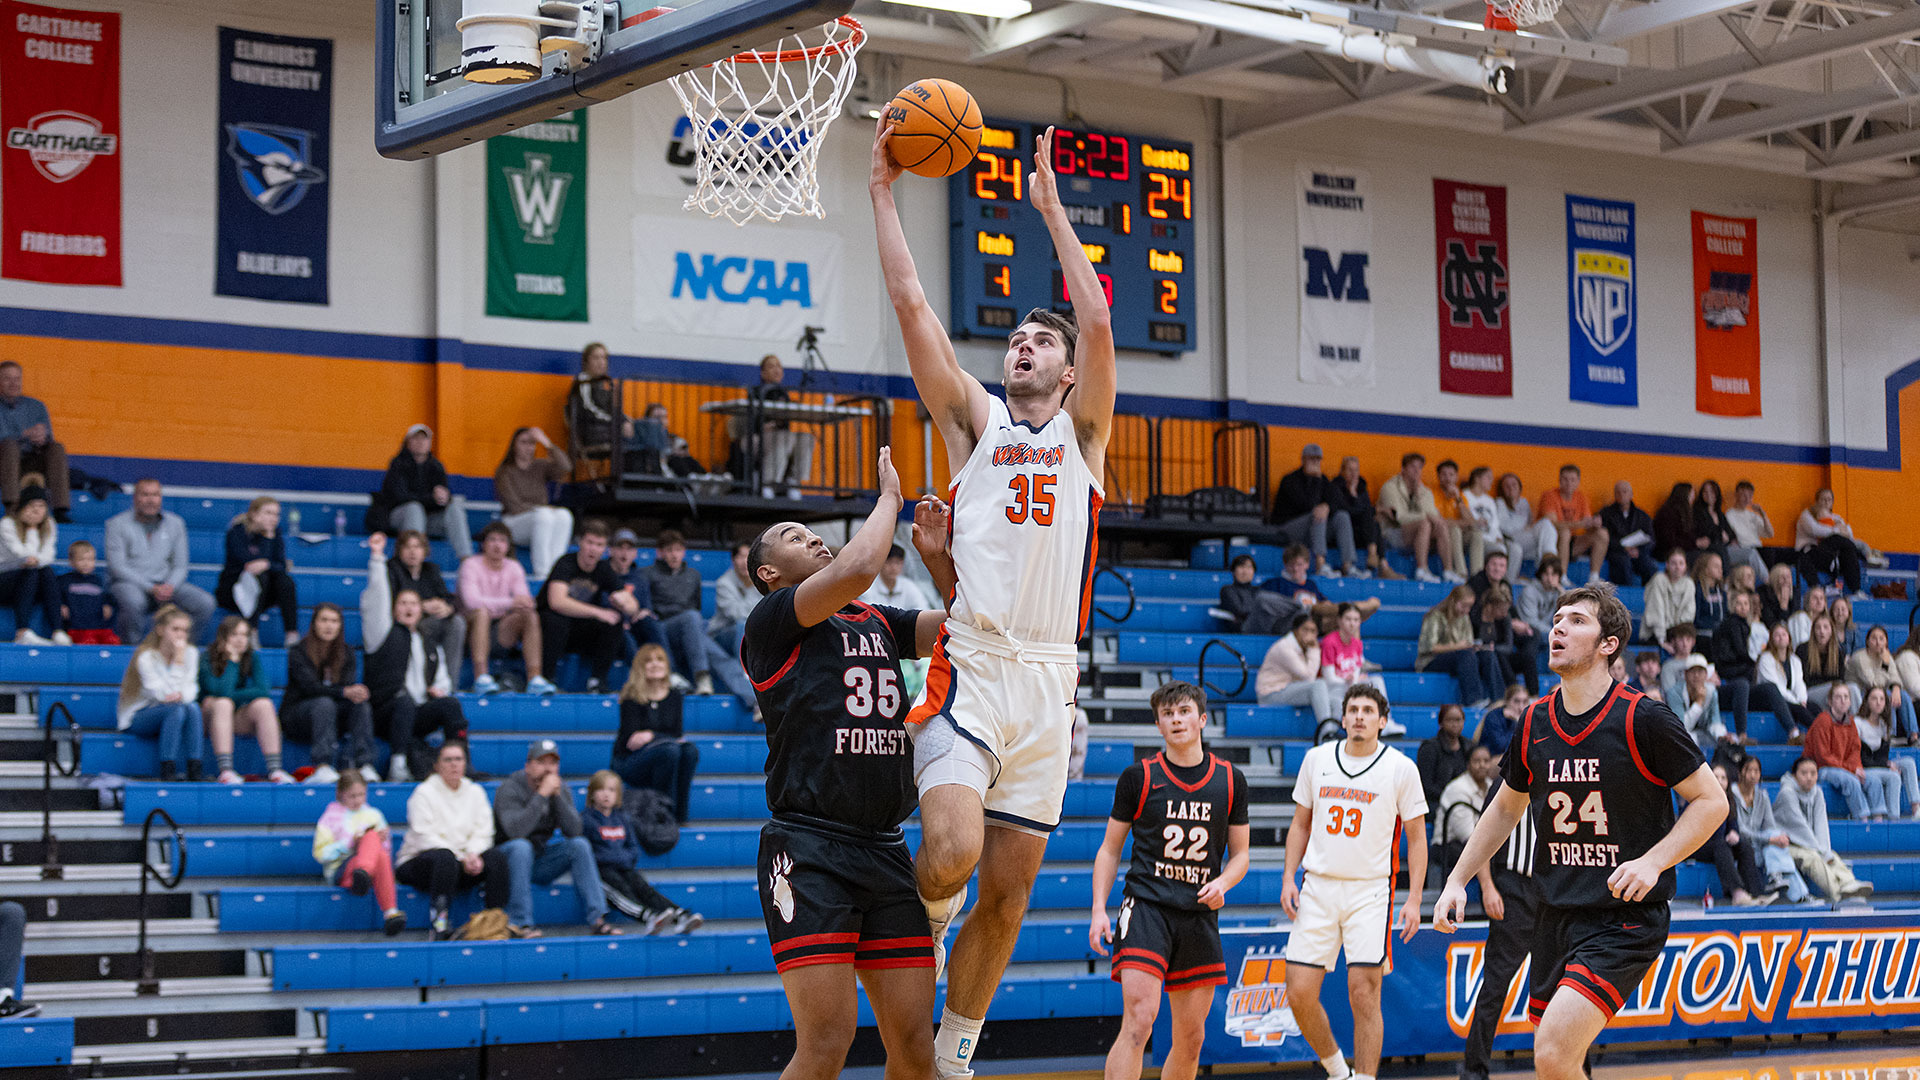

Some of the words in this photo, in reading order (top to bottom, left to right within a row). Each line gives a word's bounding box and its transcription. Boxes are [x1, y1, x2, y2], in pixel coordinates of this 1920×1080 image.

[16, 13, 103, 42] CARTHAGE
[25, 38, 94, 65] COLLEGE
[230, 61, 322, 91] UNIVERSITY
[10, 131, 112, 152] CARTHAGE
[1054, 128, 1130, 181] 6:23
[976, 152, 1022, 201] 24
[1147, 172, 1191, 220] 24
[1305, 190, 1364, 212] UNIVERSITY
[1571, 202, 1604, 223] NORTH
[1604, 206, 1630, 226] PARK
[1574, 221, 1629, 243] UNIVERSITY
[514, 273, 567, 296] TITANS
[670, 250, 813, 309] NCAA
[1302, 245, 1371, 303] M
[1160, 279, 1179, 315] 2
[1581, 276, 1628, 347] NP
[1587, 363, 1626, 385] VIKINGS
[991, 443, 1066, 468] WHEATON
[1005, 473, 1058, 527] 35
[840, 632, 889, 660] LAK
[843, 666, 901, 719] 35
[834, 727, 906, 756] FOREST
[1548, 758, 1601, 783] LAKE
[1166, 799, 1212, 822] LAKE
[1326, 804, 1363, 838] 33
[1547, 790, 1609, 837] 24
[1162, 824, 1209, 862] 22
[1547, 842, 1620, 868] FOREST
[1154, 861, 1211, 885] FOREST
